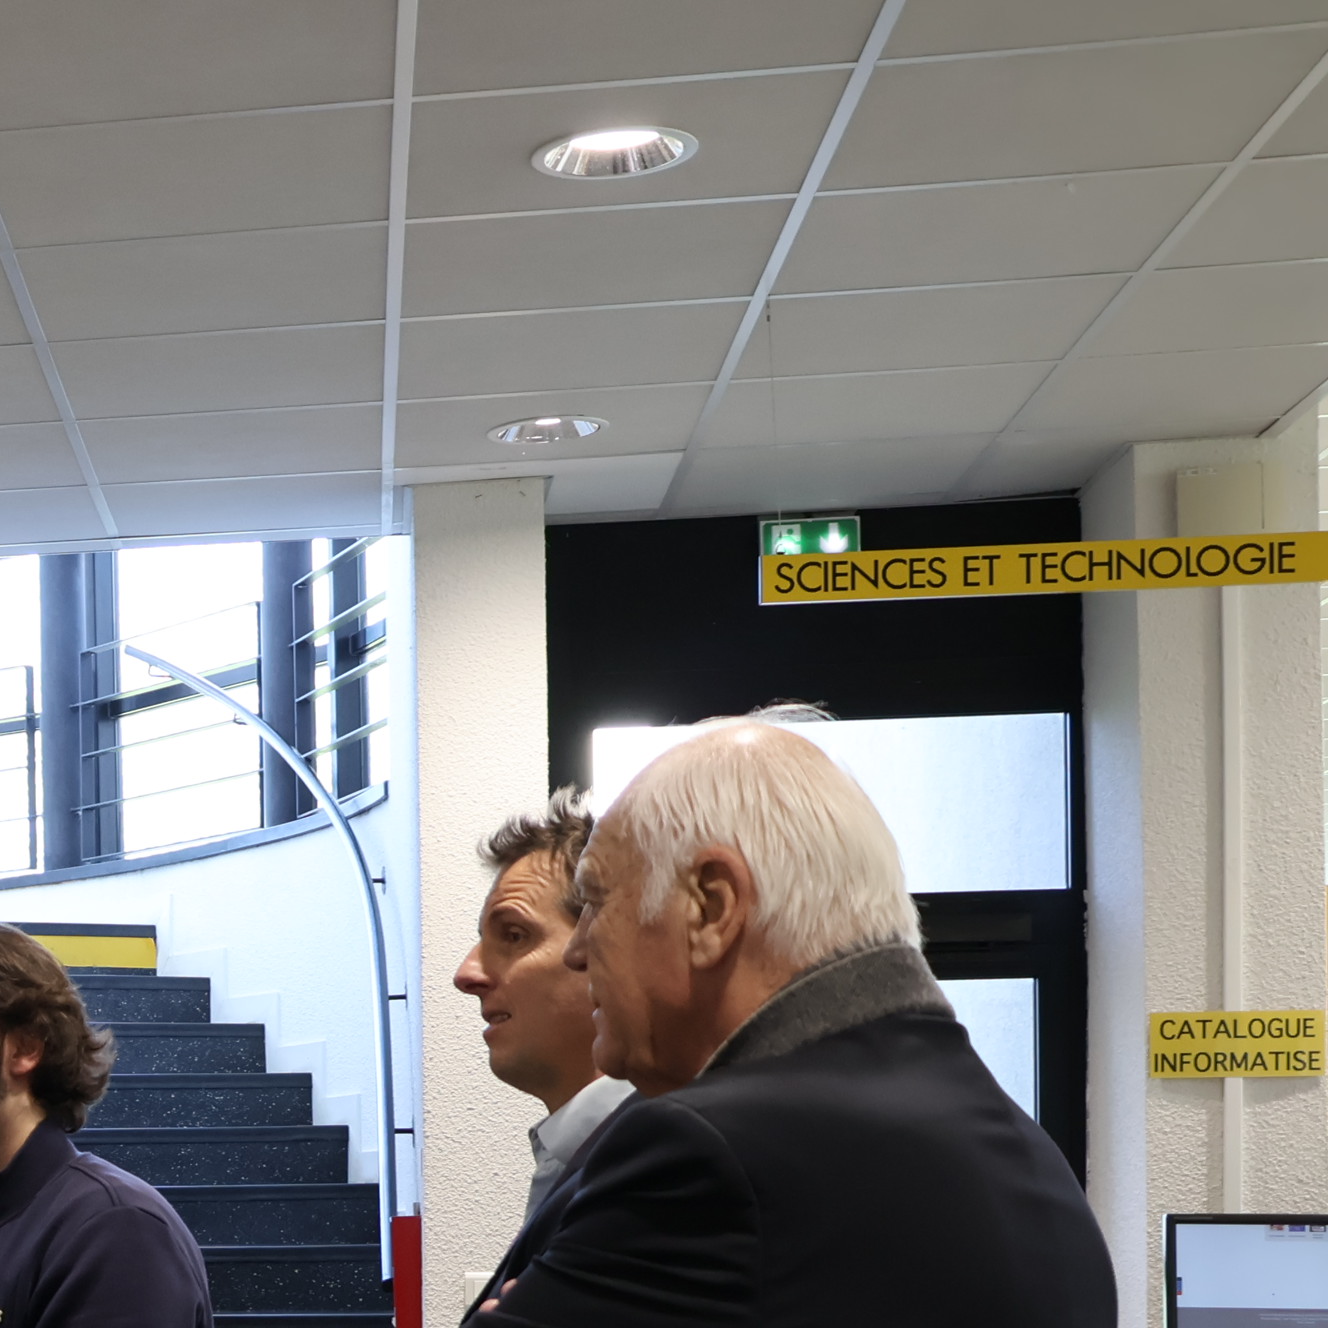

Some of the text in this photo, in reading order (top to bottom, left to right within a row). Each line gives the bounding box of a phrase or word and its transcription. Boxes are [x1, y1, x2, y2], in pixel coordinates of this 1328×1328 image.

[774, 541, 1296, 595] SCIENCES ET TECHNOLOGIE
[1159, 1017, 1316, 1041] CATALOGUE
[1153, 1050, 1321, 1073] INFORMATISE
